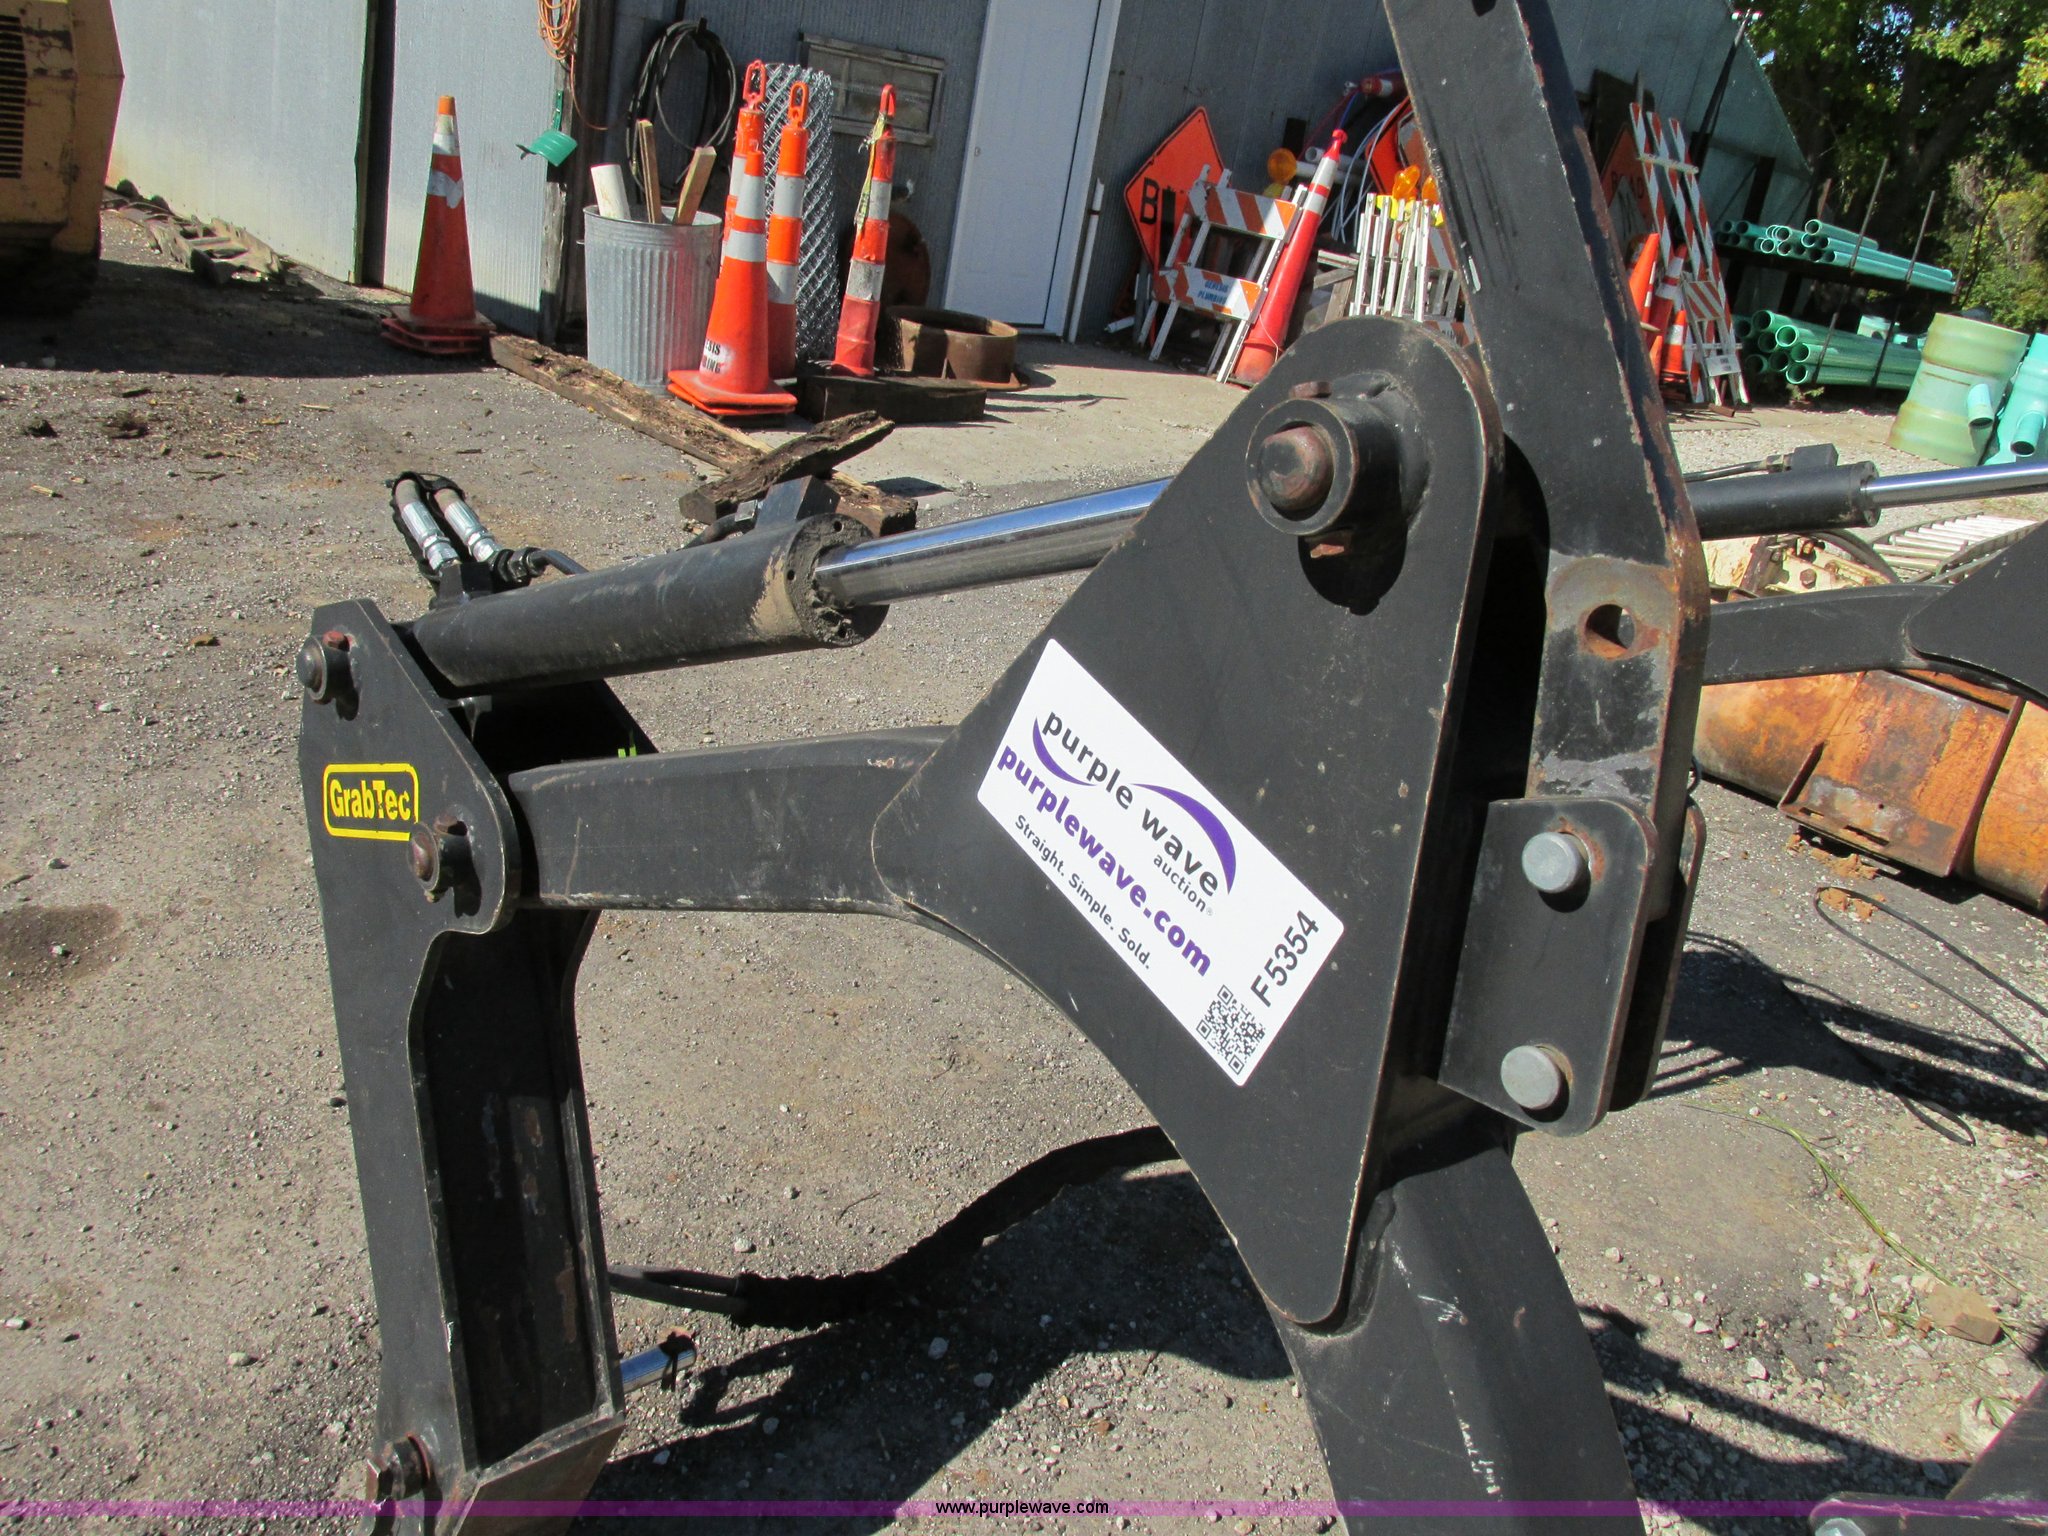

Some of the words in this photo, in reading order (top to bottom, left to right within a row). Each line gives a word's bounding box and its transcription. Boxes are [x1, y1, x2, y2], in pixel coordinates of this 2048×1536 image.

[329, 778, 411, 821] GrabTec
[996, 744, 1211, 977] purplewave.com
[1041, 711, 1135, 810] purple
[1140, 807, 1220, 897] wave
[1015, 814, 1065, 875] Straight.
[1068, 873, 1115, 931] Simple.
[1117, 928, 1151, 970] Sold.
[1250, 910, 1320, 1008] F5354
